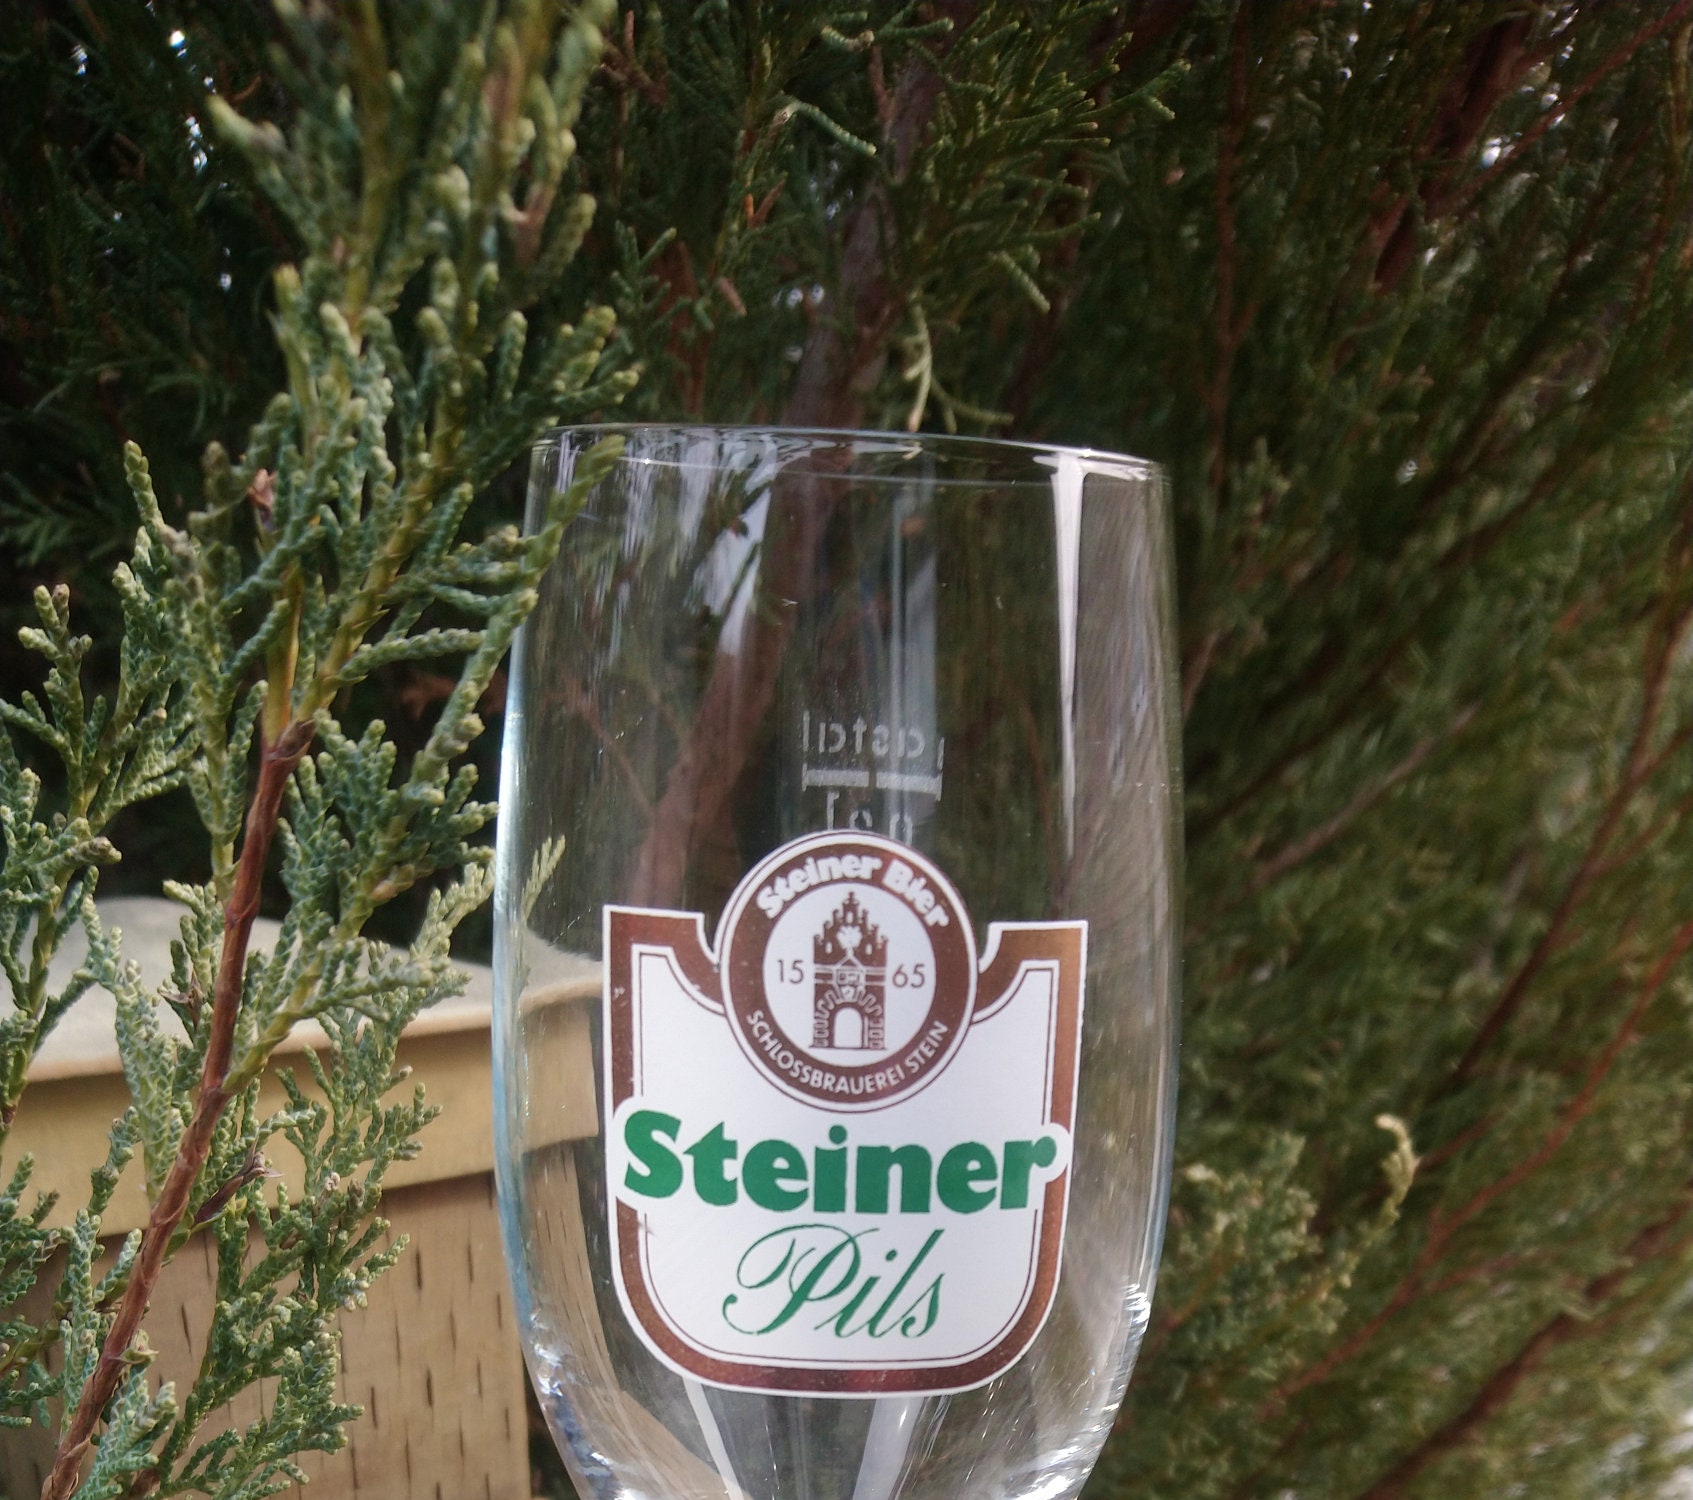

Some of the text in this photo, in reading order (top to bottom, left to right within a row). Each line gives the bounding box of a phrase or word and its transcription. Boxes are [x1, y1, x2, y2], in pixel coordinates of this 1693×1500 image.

[756, 854, 949, 928] Steiner Bier
[776, 958, 926, 989] 15 65
[746, 1009, 949, 1095] SCHLOSSBRAUEREI STEIN
[623, 1109, 1058, 1215] Steiner
[721, 1223, 945, 1339] Pils
